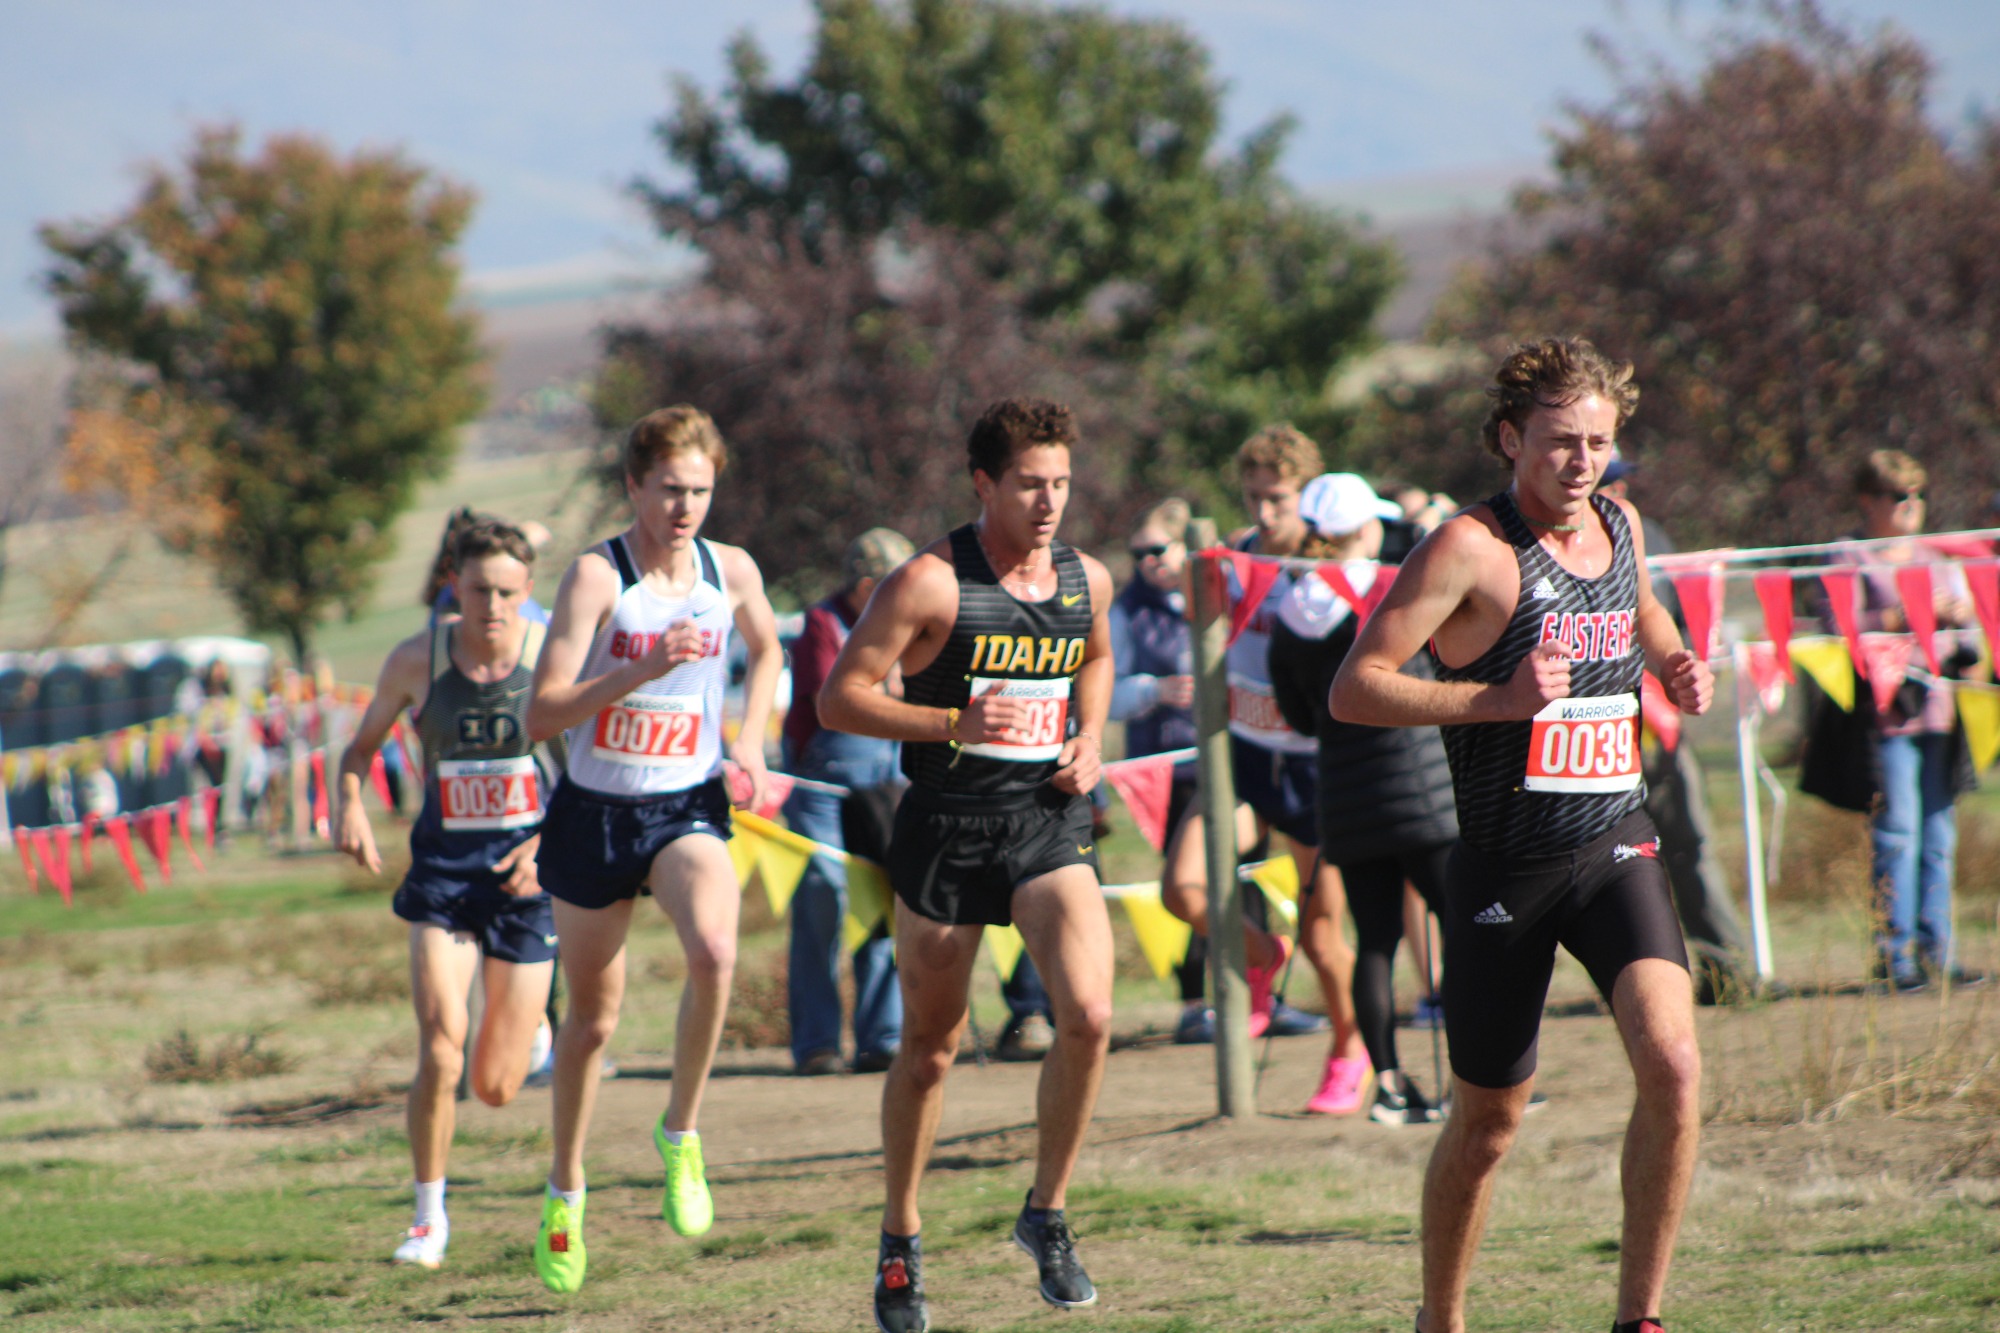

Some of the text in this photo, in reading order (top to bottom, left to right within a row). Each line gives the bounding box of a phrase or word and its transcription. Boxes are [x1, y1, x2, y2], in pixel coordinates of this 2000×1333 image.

[970, 635, 1086, 673] IDAHO
[1538, 607, 1636, 662] EASTER
[604, 708, 693, 756] 0072
[1020, 699, 1061, 746] 03
[1561, 703, 1625, 720] WARRIORS
[1541, 719, 1633, 776] 0039
[448, 775, 530, 816] 0034
[1473, 914, 1514, 924] adidas
